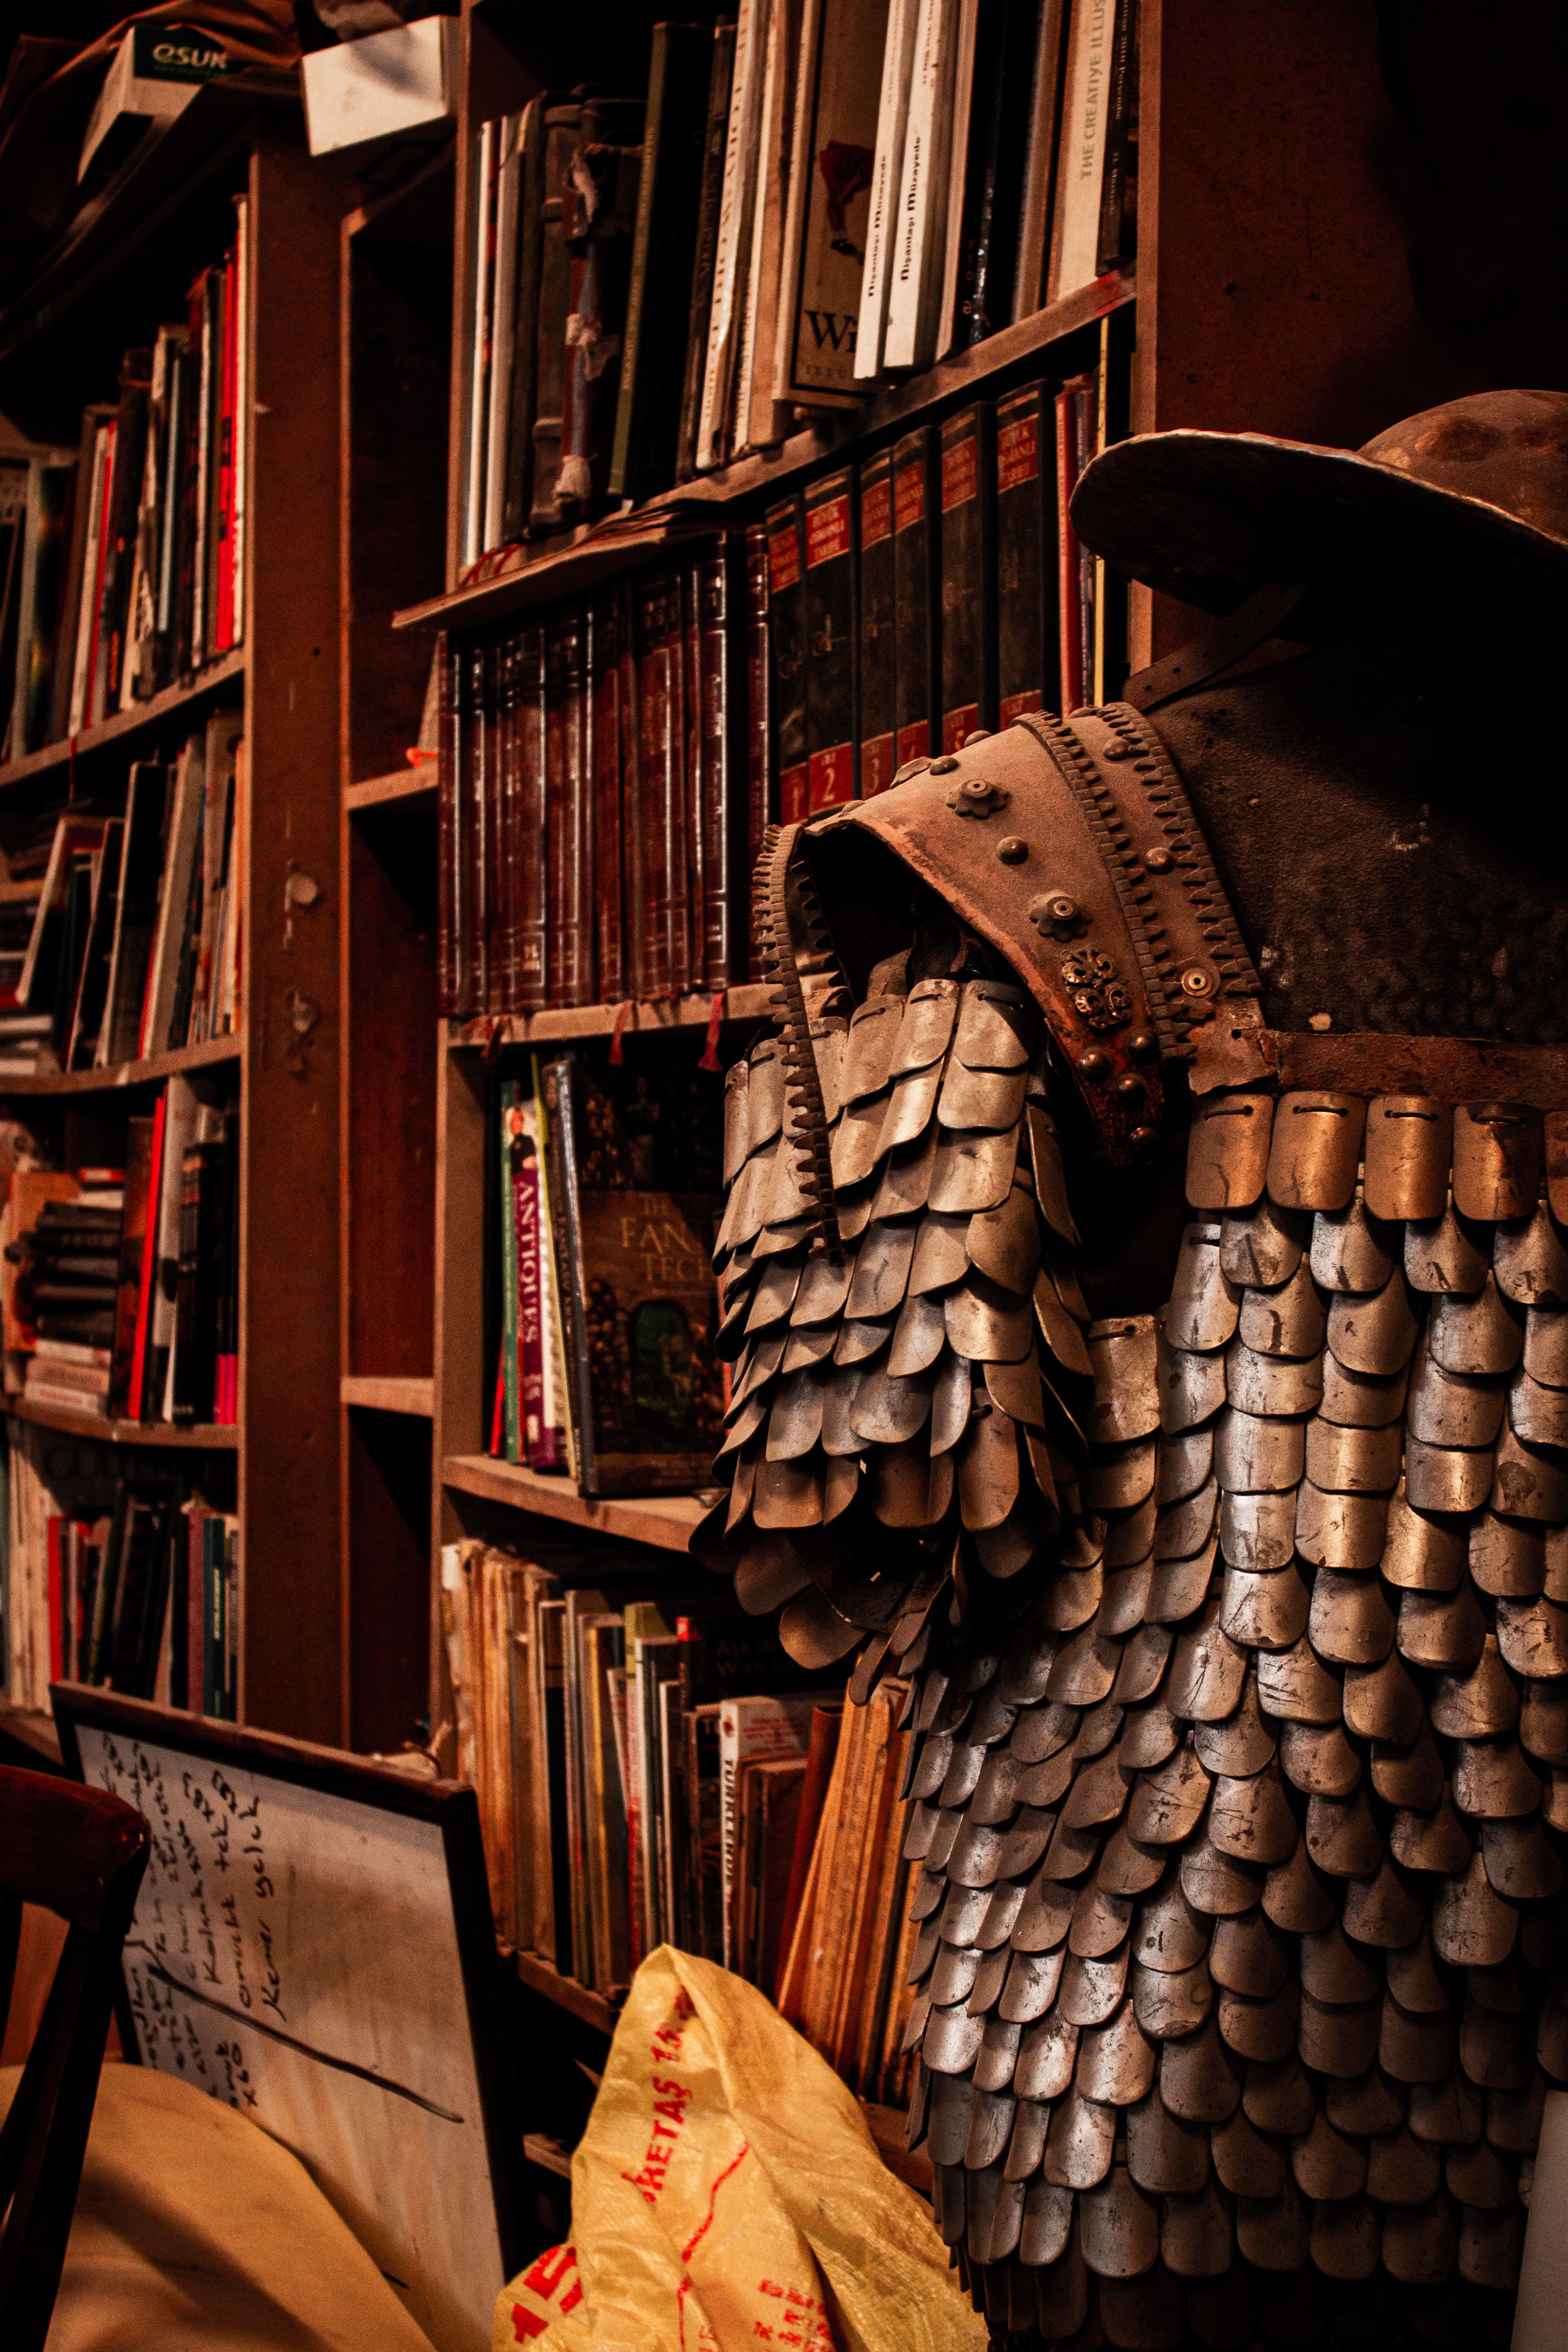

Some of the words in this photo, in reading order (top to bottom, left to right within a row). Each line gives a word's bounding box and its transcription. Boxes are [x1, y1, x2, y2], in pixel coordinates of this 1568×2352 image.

[1082, 54, 1102, 139] CREATIVE
[1080, 144, 1095, 180] THE
[822, 768, 836, 802] 2
[519, 1180, 537, 1343] ANTIQUES
